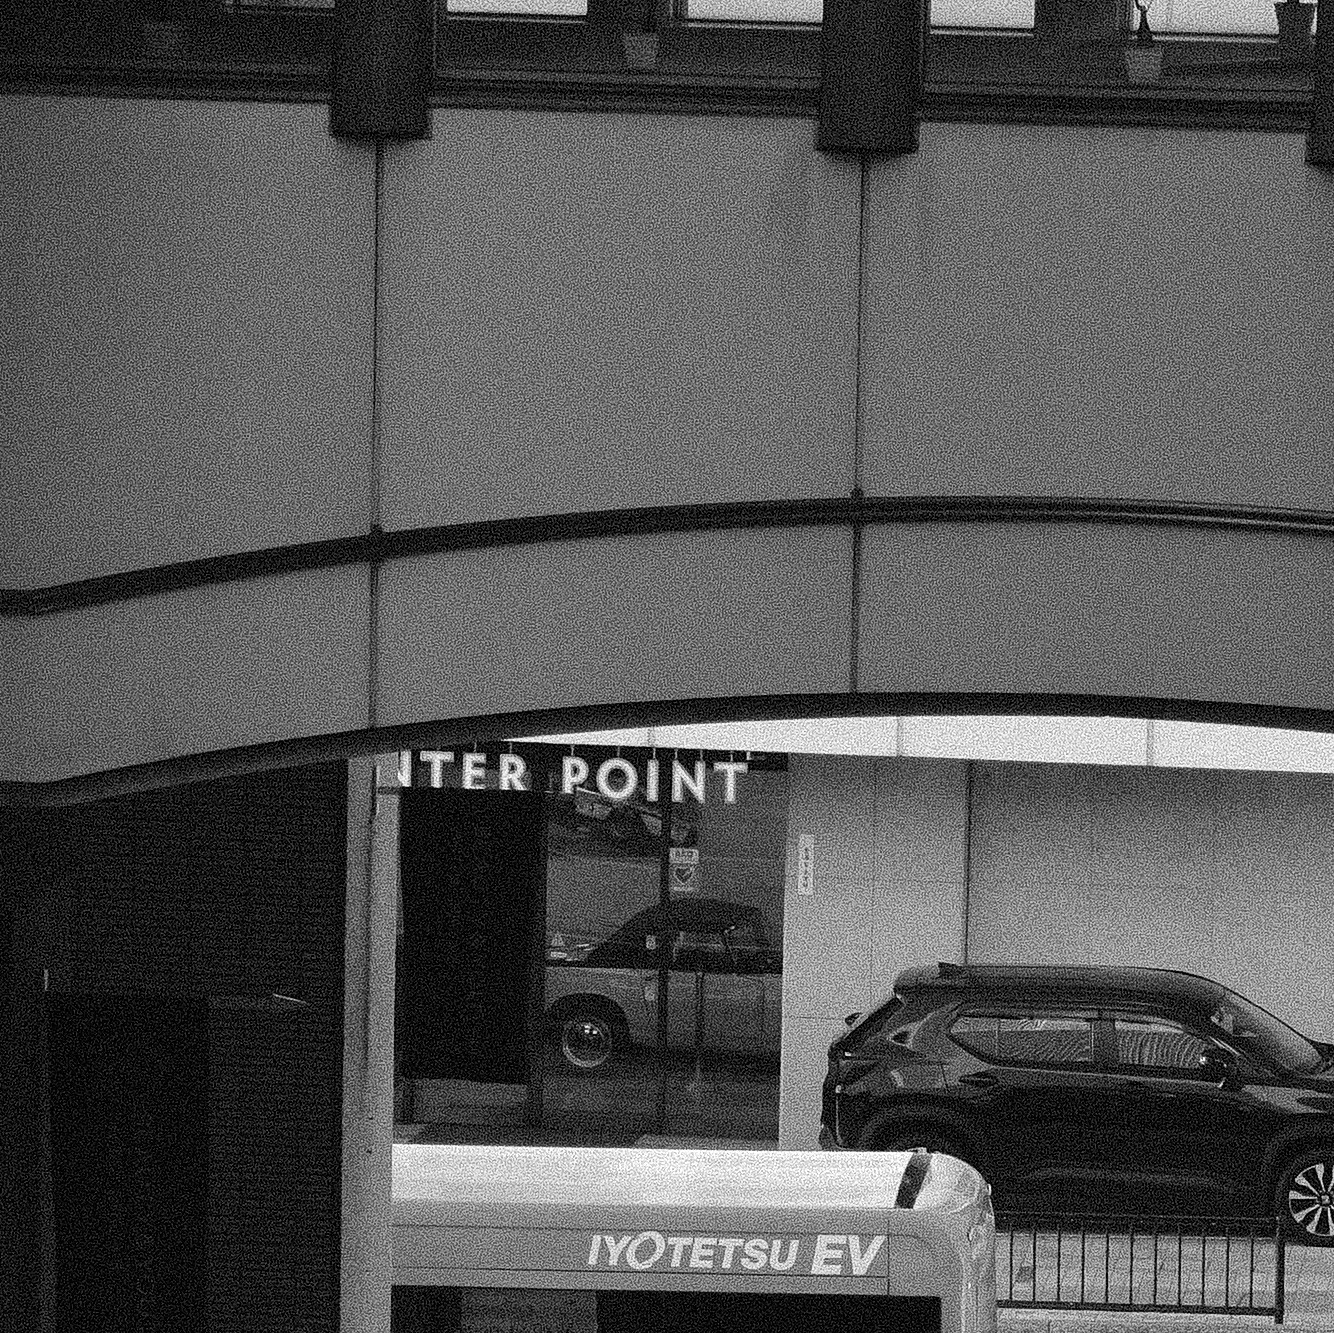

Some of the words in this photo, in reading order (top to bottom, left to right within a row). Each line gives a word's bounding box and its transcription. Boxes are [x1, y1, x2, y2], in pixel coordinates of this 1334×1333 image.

[562, 755, 748, 804] POINT
[587, 1230, 800, 1271] IYOTETSU
[810, 1233, 887, 1276] EV
